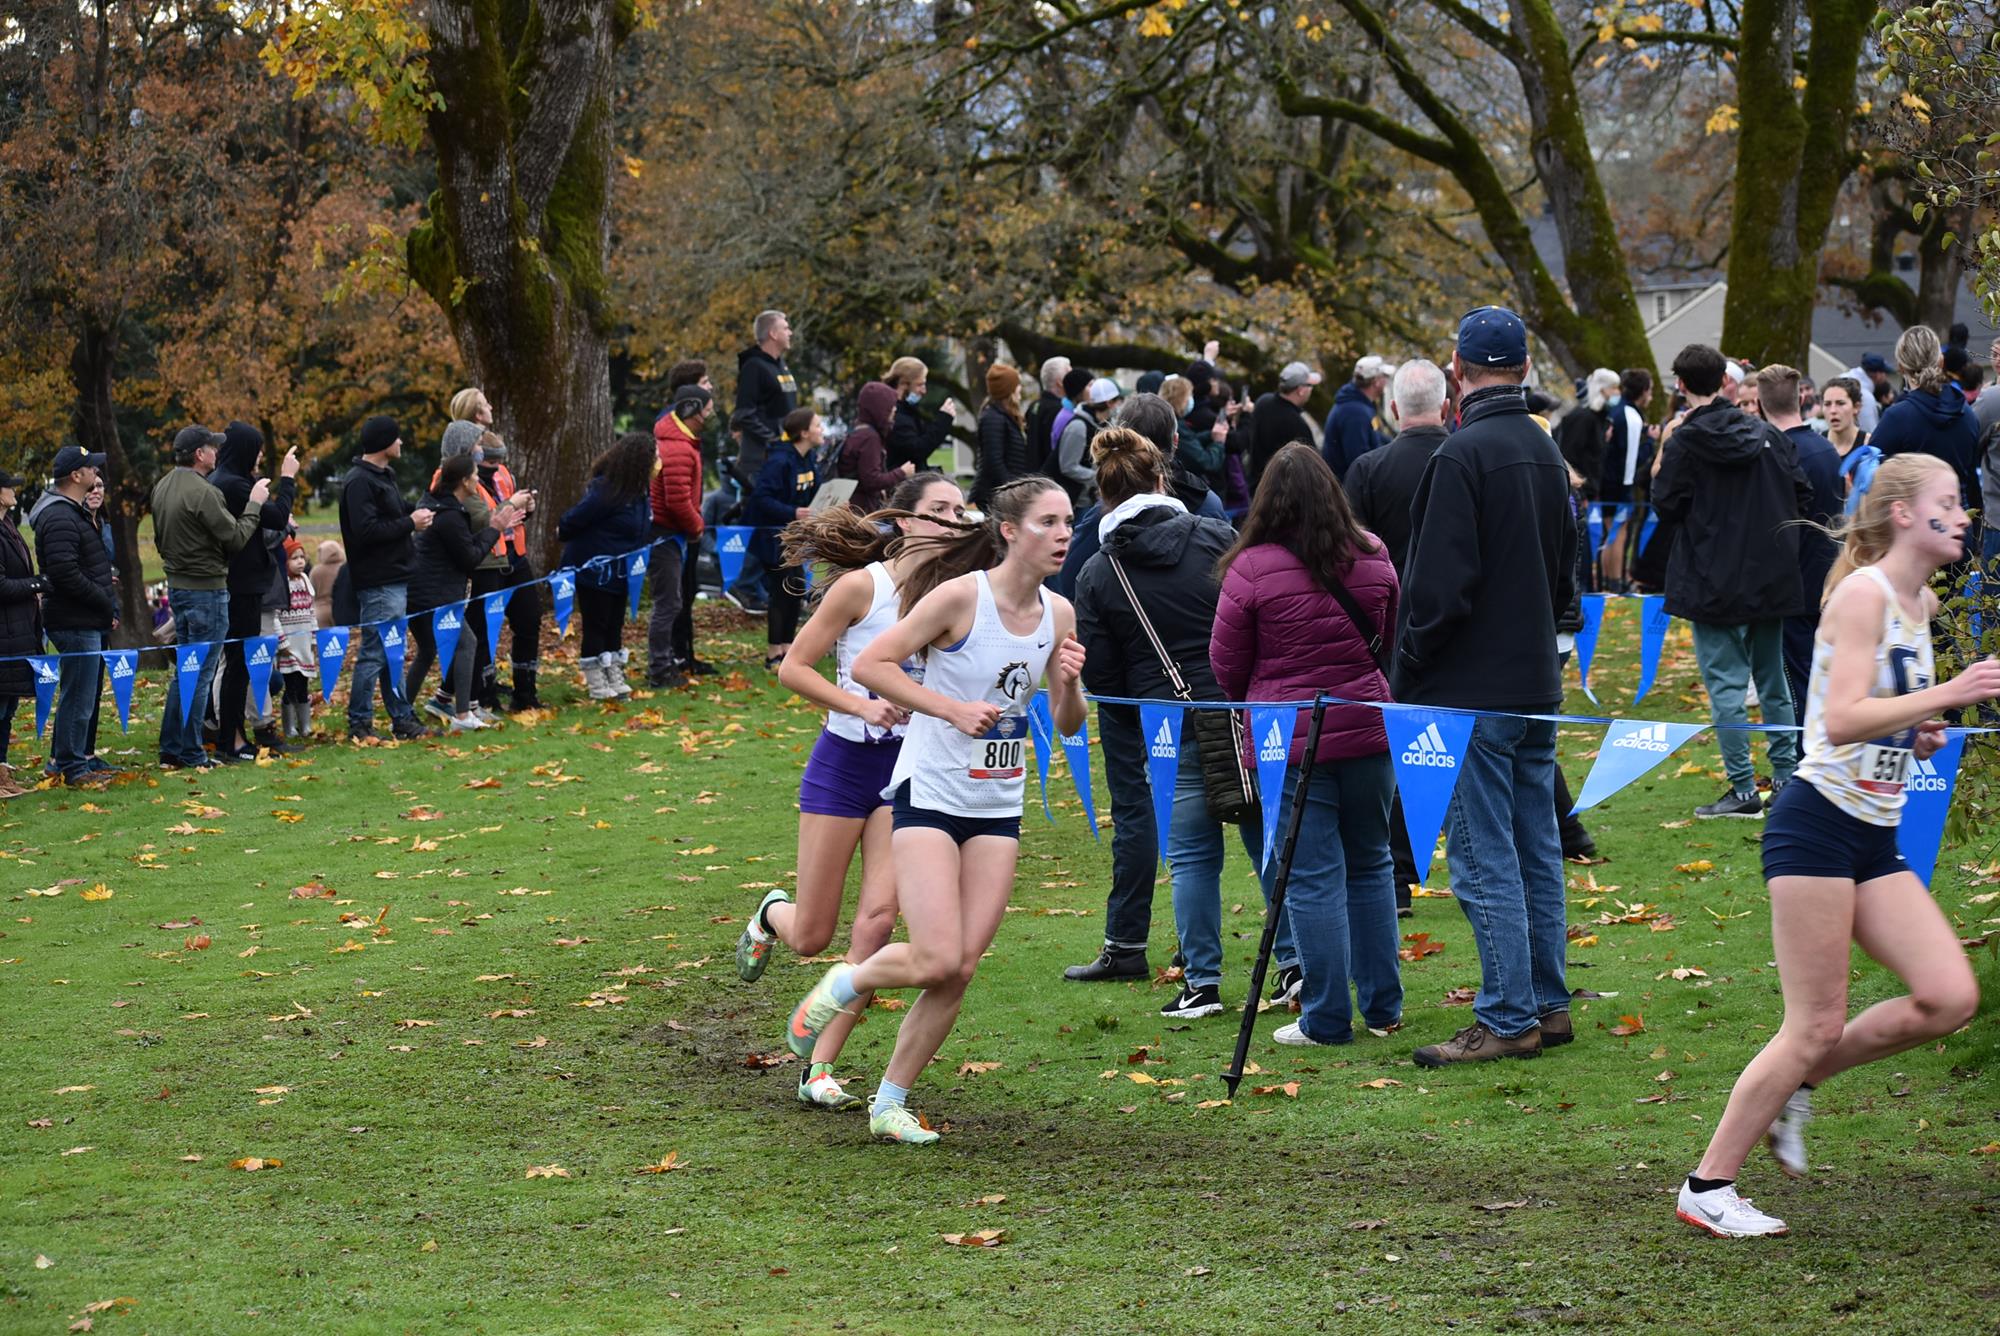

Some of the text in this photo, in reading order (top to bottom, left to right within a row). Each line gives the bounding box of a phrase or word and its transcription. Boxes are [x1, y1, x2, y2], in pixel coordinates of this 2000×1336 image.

[1151, 743, 1177, 758] adidas
[1612, 737, 1670, 752] adidas
[984, 741, 1020, 768] 800
[1260, 746, 1286, 761] adidas
[1401, 749, 1456, 768] adidas
[1902, 774, 1947, 792] didas
